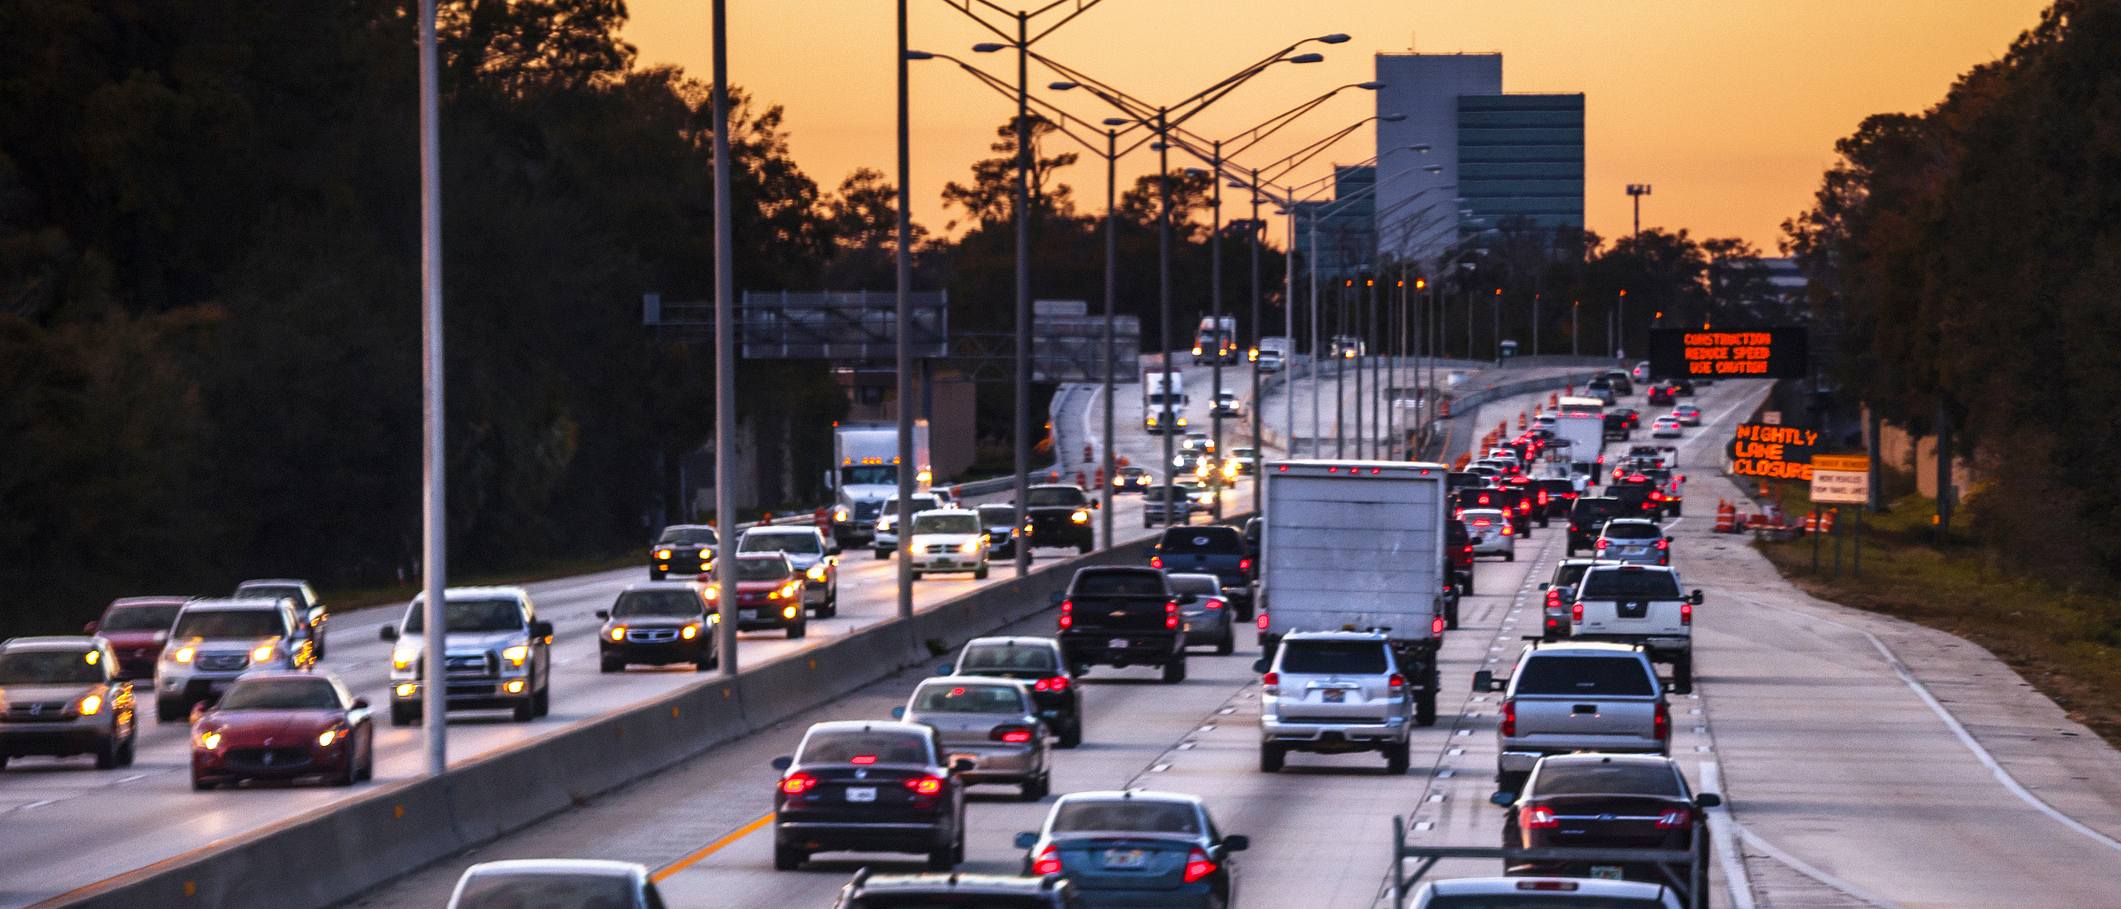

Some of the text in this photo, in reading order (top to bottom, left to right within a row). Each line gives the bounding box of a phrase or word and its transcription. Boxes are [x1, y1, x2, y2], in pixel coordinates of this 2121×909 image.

[1684, 332, 1772, 346] CONSTRUCTION
[1685, 346, 1771, 360] REDUCE SPEED
[1689, 360, 1768, 374] USE CAUTION
[1737, 424, 1818, 446] NIGHTLY
[1735, 440, 1784, 461] LANE
[1734, 458, 1813, 481] CLOSURE
